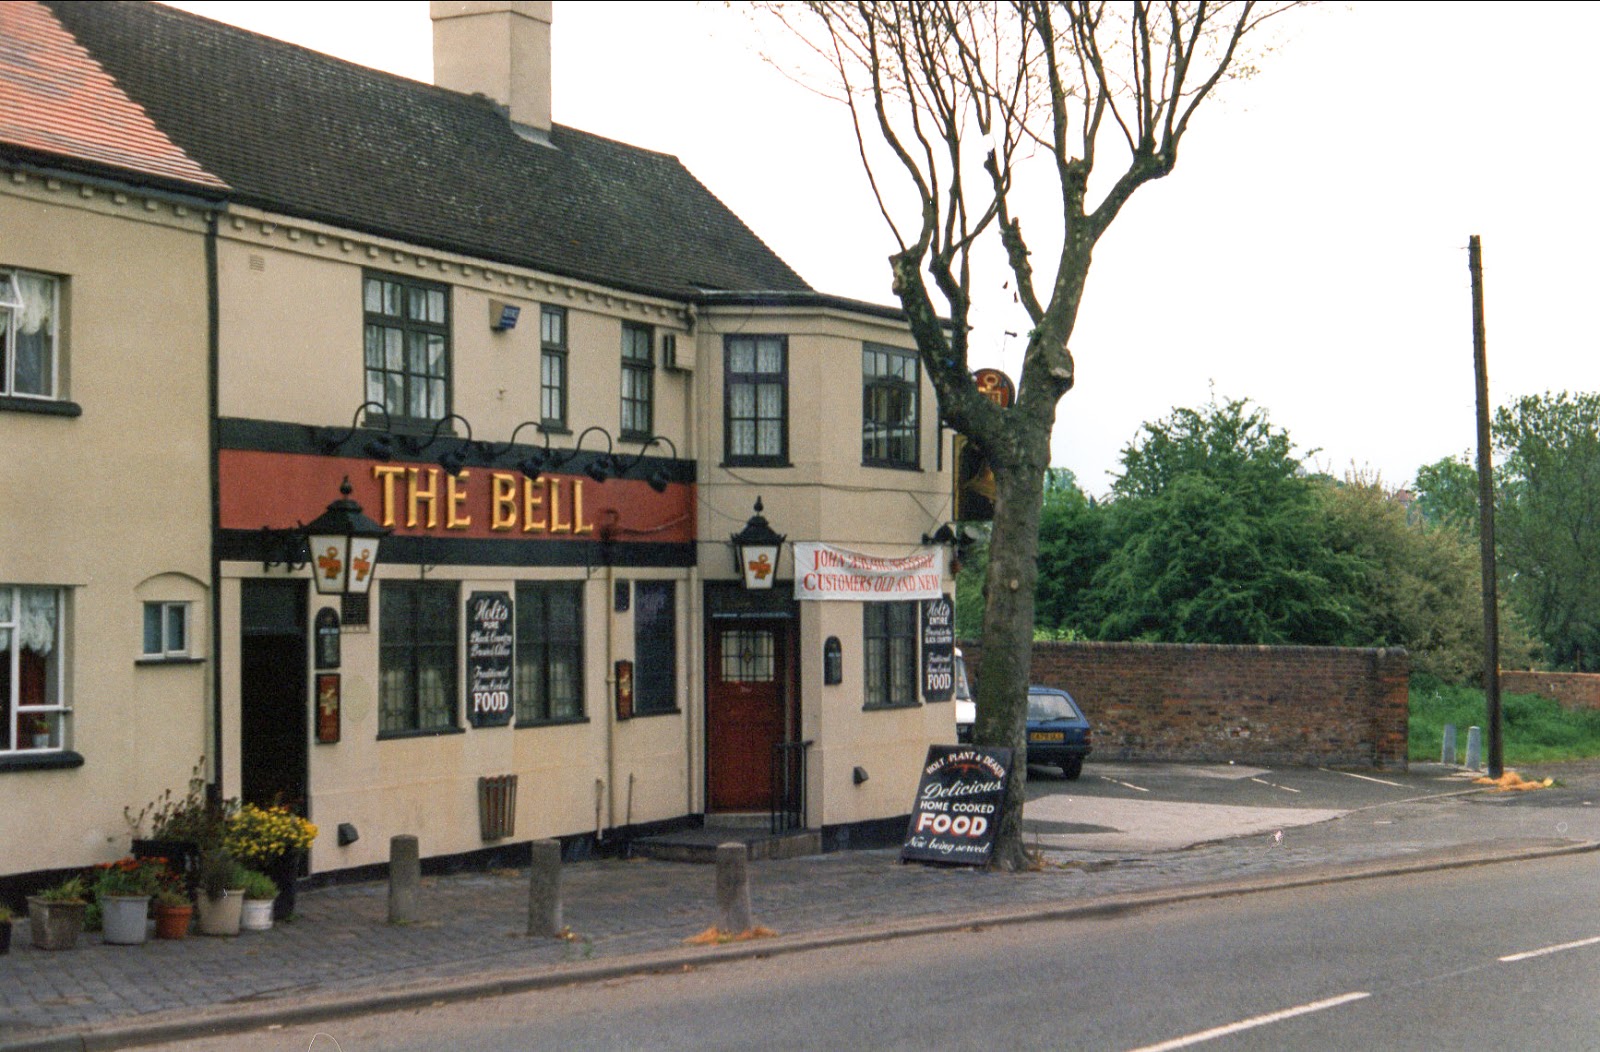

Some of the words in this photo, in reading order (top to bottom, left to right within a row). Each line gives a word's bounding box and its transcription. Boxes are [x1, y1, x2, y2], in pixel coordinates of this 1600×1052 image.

[374, 465, 472, 529] THE
[492, 472, 594, 535] BELL
[803, 573, 872, 592] CUSTOMERS
[874, 575, 895, 593] OLD
[895, 575, 916, 592] AND
[918, 574, 940, 591] NEW
[475, 599, 508, 620] Holt's
[927, 673, 952, 690] FOOD
[474, 692, 509, 712] FOOD
[926, 757, 945, 774] HOLT
[948, 751, 976, 762] PLANT
[921, 780, 1003, 800] Delicious
[920, 800, 949, 812] HOME
[952, 803, 995, 814] COOKED
[916, 812, 988, 838] FOOD
[905, 836, 927, 848] Now
[928, 838, 955, 854] being
[955, 842, 990, 853] served
